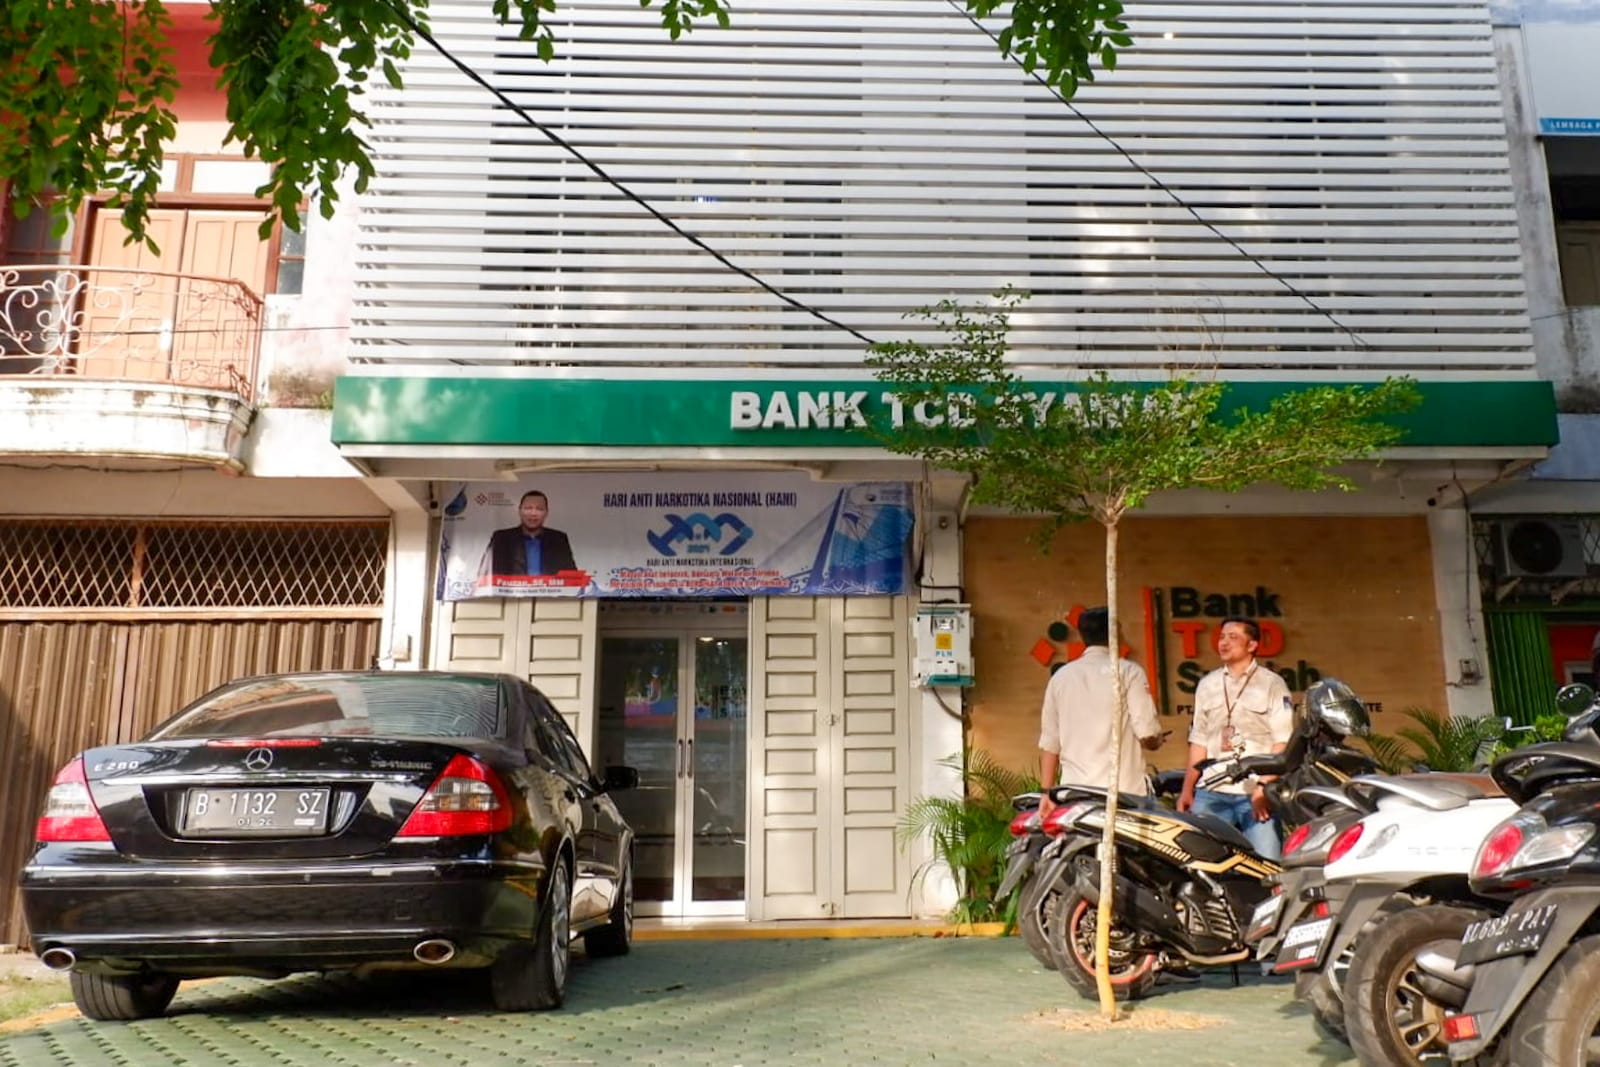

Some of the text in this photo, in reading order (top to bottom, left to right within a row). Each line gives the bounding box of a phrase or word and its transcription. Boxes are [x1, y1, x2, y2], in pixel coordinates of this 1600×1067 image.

[731, 391, 868, 429] BANK
[882, 391, 976, 428] TCD
[604, 491, 797, 508] HARI ANTI NARKOTIKA NASIONAL (HANI)
[1170, 587, 1281, 618] Bank
[195, 792, 323, 815] B 1132 SZ
[1518, 903, 1558, 932] PAY
